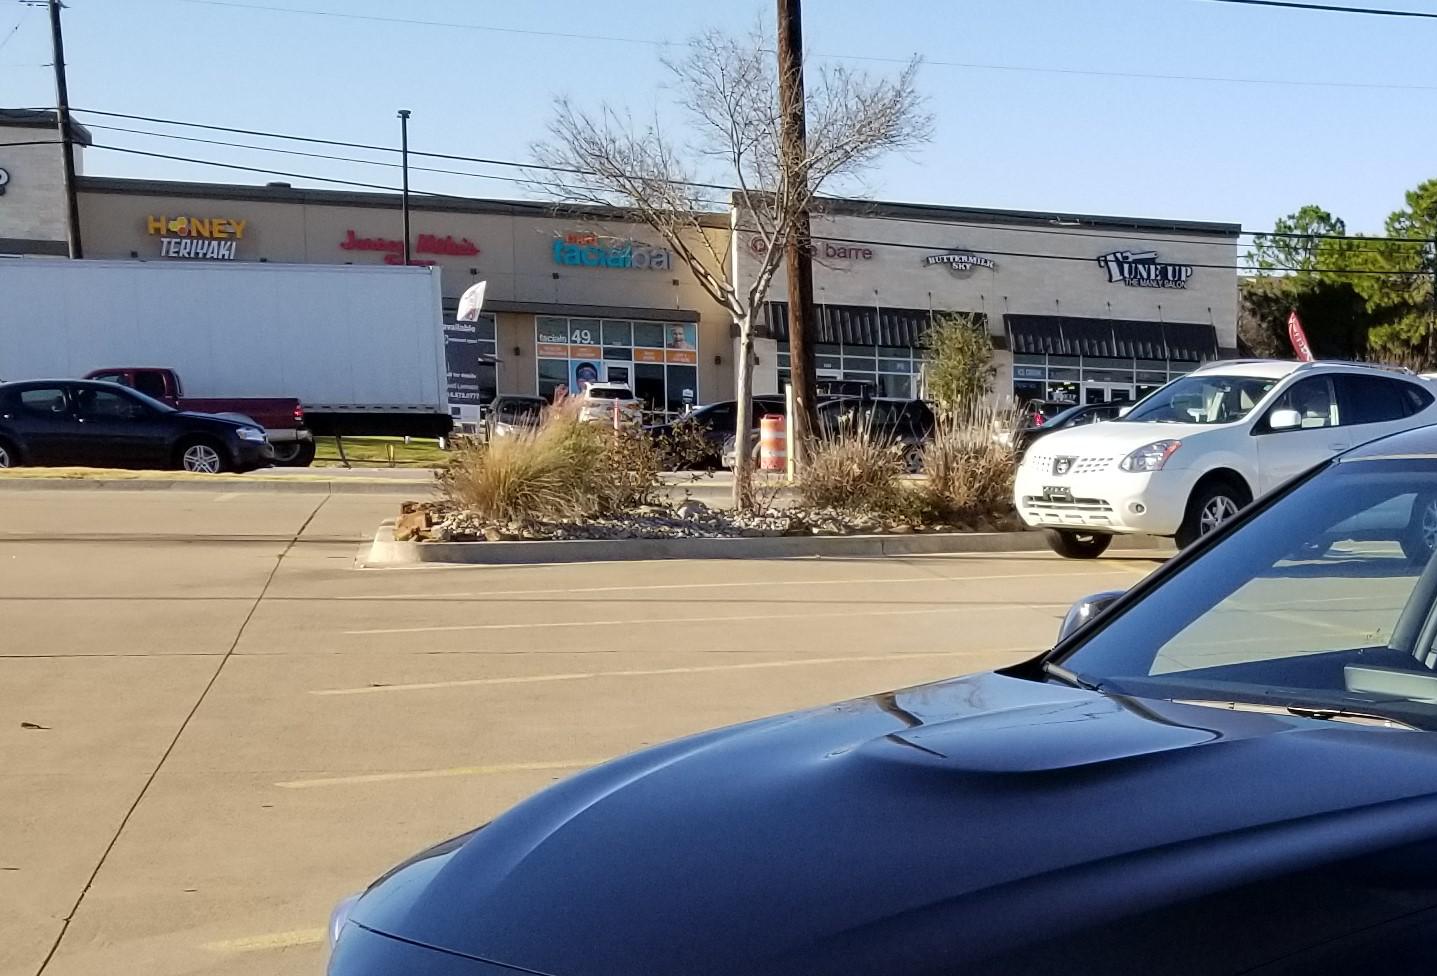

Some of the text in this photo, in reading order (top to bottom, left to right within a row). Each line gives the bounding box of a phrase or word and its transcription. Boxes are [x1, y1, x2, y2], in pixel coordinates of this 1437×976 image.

[160, 237, 237, 260] TERIYAKI
[826, 243, 873, 260] barre
[927, 254, 994, 269] BUTTERMILK
[952, 261, 972, 271] SKY
[1167, 265, 1193, 282] UP
